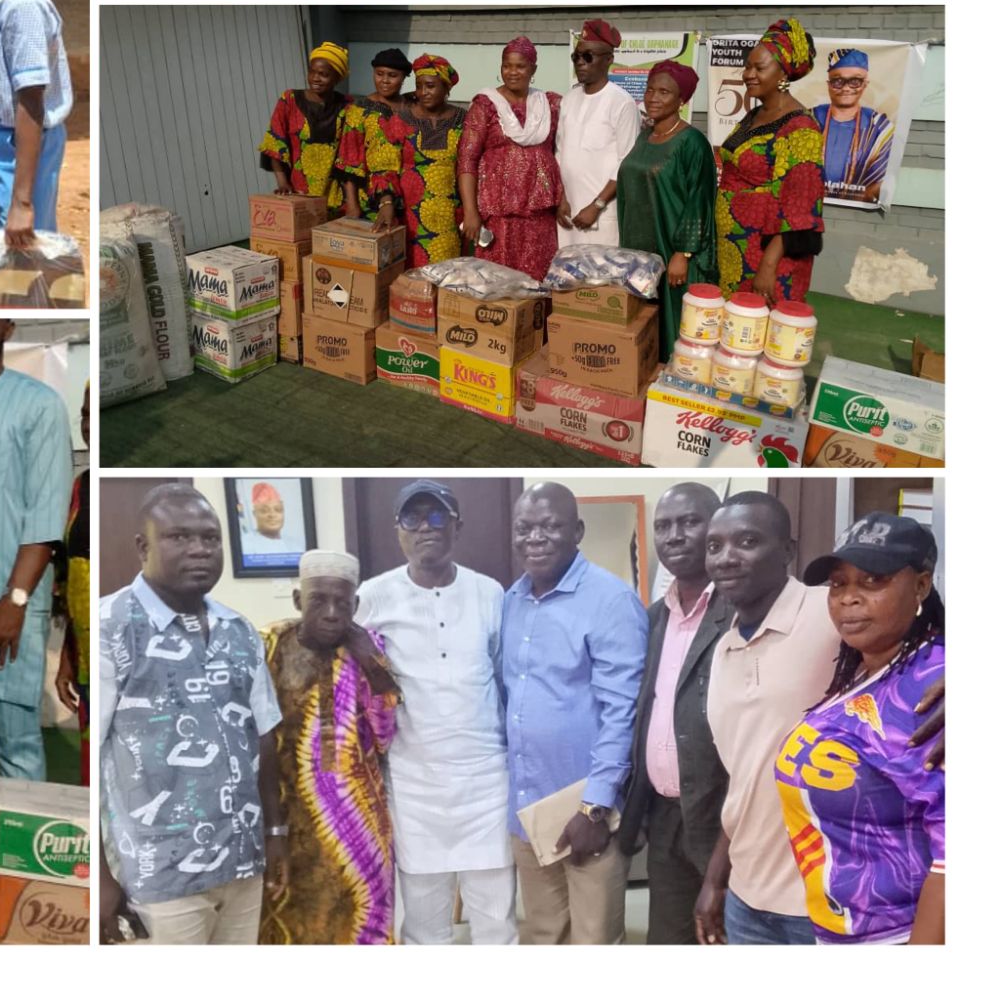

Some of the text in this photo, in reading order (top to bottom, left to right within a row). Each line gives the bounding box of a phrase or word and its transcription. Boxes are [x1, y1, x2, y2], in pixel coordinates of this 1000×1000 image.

[712, 49, 743, 58] YOUTH
[712, 59, 744, 67] FORUM
[188, 269, 229, 297] Mama
[241, 280, 275, 304] Mama
[478, 308, 504, 320] MILO
[155, 320, 170, 361] FLOUR
[193, 325, 229, 353] Mama
[317, 334, 348, 346] PROMO
[450, 330, 475, 342] MILO
[240, 336, 273, 361] Mama
[487, 338, 507, 354] 2kg
[574, 342, 617, 354] PROMO
[551, 384, 606, 410] Kellogg's
[560, 407, 588, 423] CORN
[560, 418, 587, 432] FLAKES
[676, 410, 757, 446] Kellogg's
[677, 430, 711, 449] CORN
[677, 440, 710, 457] FLAKES
[40, 832, 90, 855] Purit
[138, 848, 157, 880] YORK
[27, 899, 90, 933] Viva
